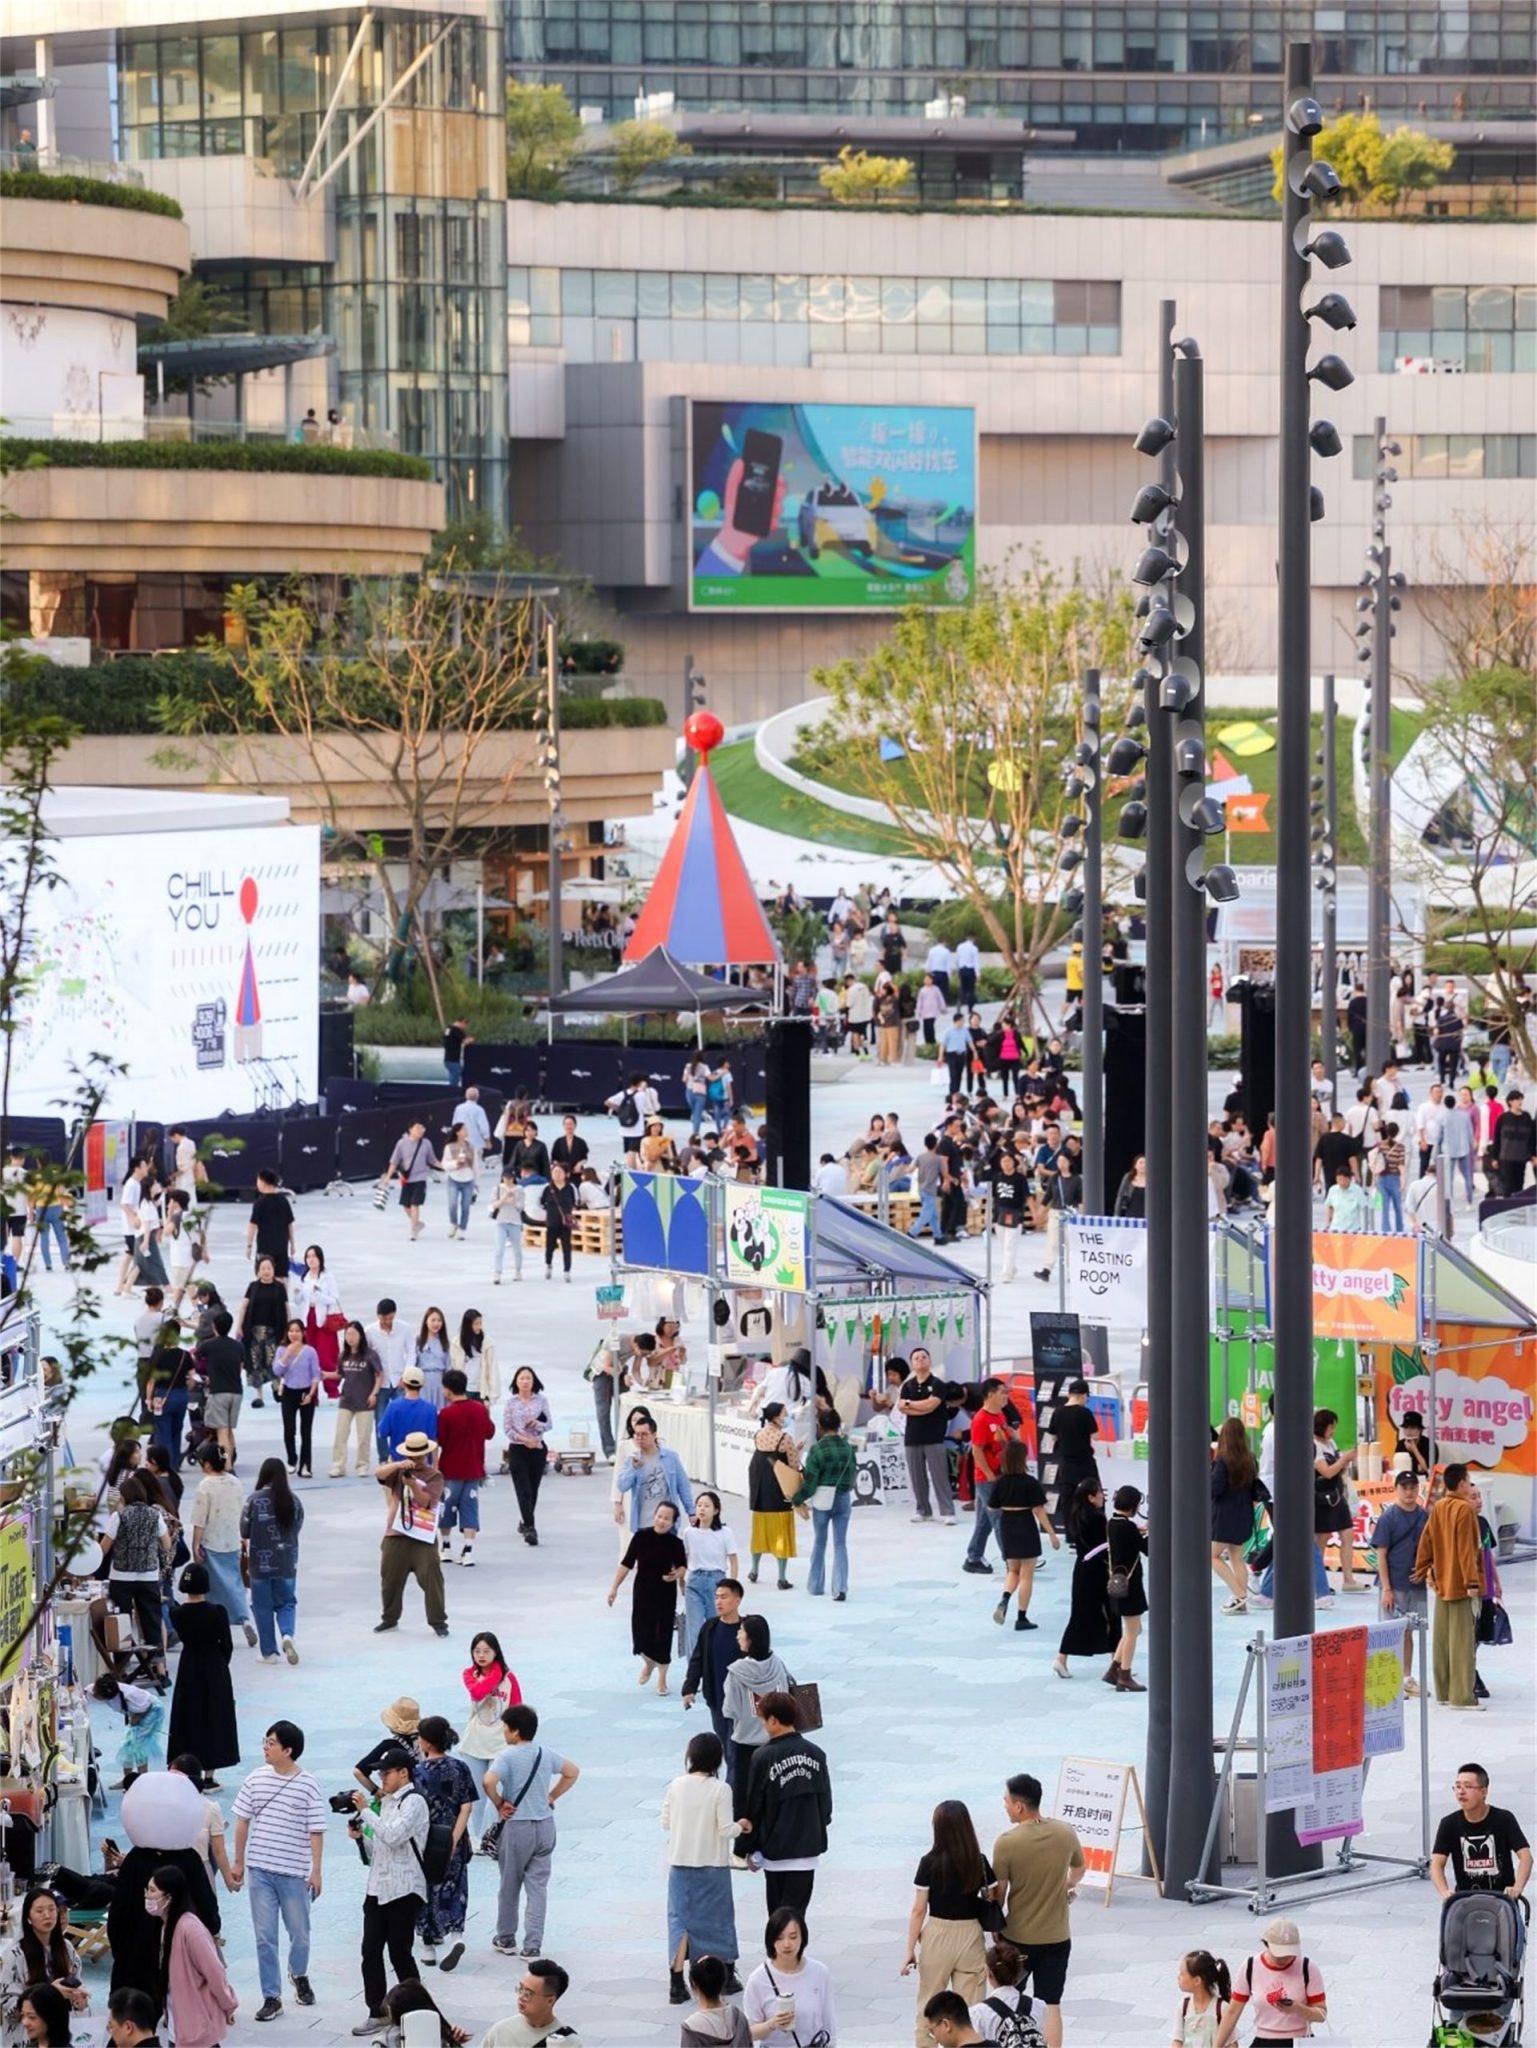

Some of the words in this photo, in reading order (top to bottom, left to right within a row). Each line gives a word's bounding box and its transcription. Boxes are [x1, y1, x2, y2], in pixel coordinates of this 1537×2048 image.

[168, 870, 234, 900] CHILL
[168, 903, 219, 932] YOU
[1079, 1232, 1104, 1245] THE
[1080, 1250, 1133, 1267] TASTING
[1080, 1269, 1120, 1284] ROOM
[1343, 1274, 1389, 1294] angel
[1463, 1396, 1531, 1426] angel
[769, 1753, 820, 1782] Champion
[1062, 1804, 1113, 1823] 开启时间
